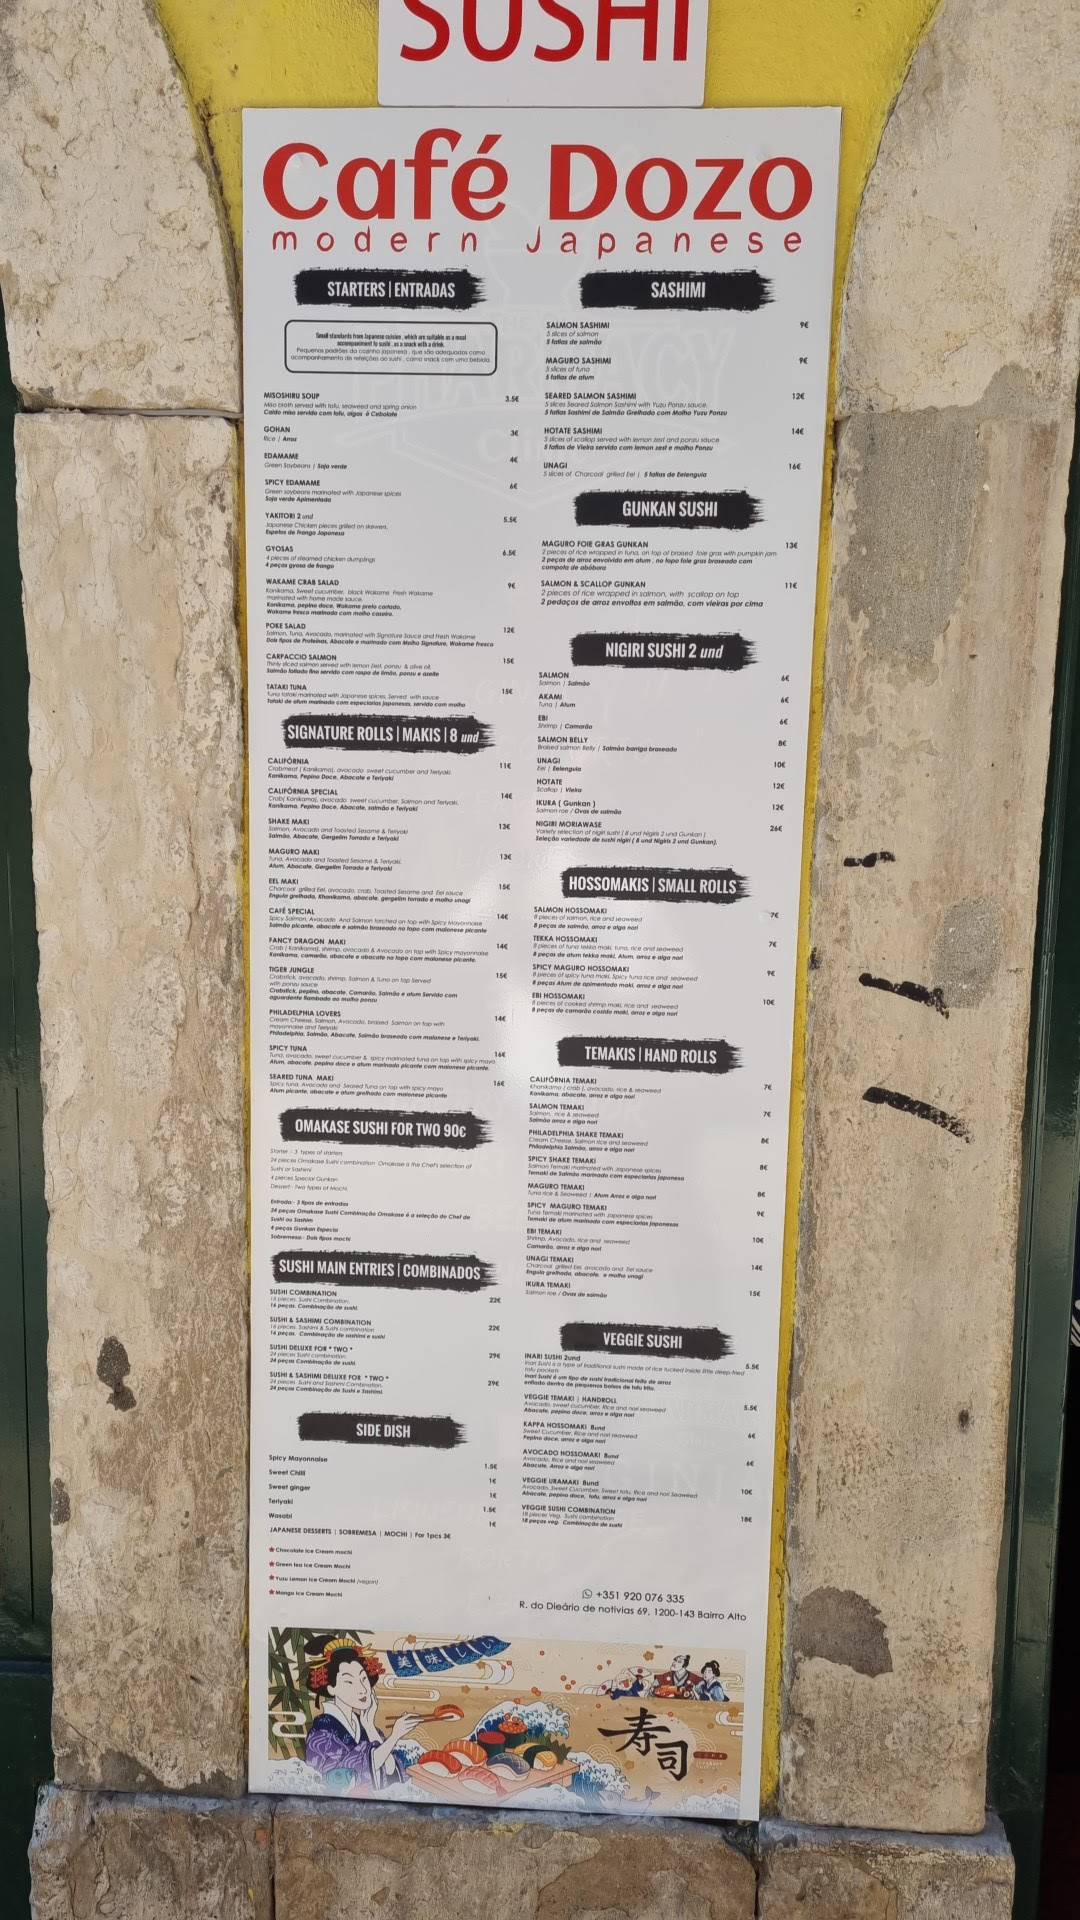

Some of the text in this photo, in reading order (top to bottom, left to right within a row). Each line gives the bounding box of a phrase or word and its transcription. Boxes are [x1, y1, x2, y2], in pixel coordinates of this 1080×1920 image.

[401, 0, 689, 62] SUSHI
[263, 128, 812, 221] Café Dozo
[272, 227, 478, 252] modern
[327, 281, 455, 298] STARTERS ENTRADAS
[650, 281, 706, 298] SASHIMI
[546, 321, 610, 329] SALMON SASHIMI
[545, 356, 611, 364] MAGURO SASHIMI
[263, 425, 290, 433] GOHAN
[264, 478, 284, 486] SPICY
[622, 500, 717, 517] GUNKAN SUSHI
[265, 544, 293, 552] GYOSAS
[541, 539, 575, 547] MAGURO
[594, 540, 614, 548] GRAS
[616, 540, 648, 548] GUNKAN
[265, 577, 339, 586] WAKAME CRAB SALAD
[540, 579, 571, 587] SALMON
[580, 579, 612, 588] SCALLOP
[613, 580, 646, 588] GUNKAN
[580, 598, 590, 606] de
[744, 600, 763, 608] cima
[605, 641, 724, 658] NIGIRI SUSHI 2 und
[308, 653, 337, 661] SALMON
[538, 692, 562, 700] AKAMI
[284, 724, 479, 743] SIGNATURE ROLLS MAKIS 8 und
[537, 735, 588, 744] SALMON BELLY
[310, 788, 338, 796] SPECIAL
[267, 817, 290, 825] SHAKE
[558, 820, 602, 828] MORIAWASE
[568, 875, 740, 894] HOSSOMAKIS SMALL ROLLS
[287, 907, 315, 915] SPECIAL
[564, 906, 607, 914] HOSSOMAKI
[268, 936, 292, 944] FANCY
[268, 965, 314, 974] TIGER JUNGLE
[532, 963, 629, 972] SPICY MAGURO HOSSOMAKI
[268, 1008, 314, 1016] PHILADELPHIA
[584, 1046, 716, 1064] TEMAKIS HAND ROLLS
[294, 1118, 350, 1134] OMAKASE
[352, 1120, 388, 1135] SUSHI
[391, 1121, 413, 1136] FOR
[415, 1122, 440, 1136] TWO
[528, 1128, 574, 1137] PHILADELPHIA
[575, 1130, 597, 1138] SHAKE
[549, 1255, 574, 1263] TEMAKI
[278, 1258, 481, 1280] SUSHI MAIN ENTRIES COMBINADOS
[295, 1316, 322, 1324] SASHIMI
[323, 1318, 371, 1326] COMBINATION
[603, 1331, 682, 1348] VEGGIE SUSHI
[550, 1394, 574, 1402] TEMAKI
[581, 1395, 617, 1403] HANDROLL
[356, 1422, 410, 1438] SIDE DISH
[287, 1455, 328, 1463] Mayonnaise
[521, 1503, 546, 1511] VEGGIE
[567, 1506, 616, 1514] COMBINATION
[269, 1526, 408, 1538] JAPANESE DESSERTS SOBREMESA MOCHI
[596, 1589, 684, 1604] +351 920 076 335
[530, 1601, 543, 1610] do
[582, 1603, 595, 1613] de
[697, 1610, 724, 1620] Bairro
[726, 1611, 747, 1621] Alto
[597, 1706, 689, 1781] 寿司
